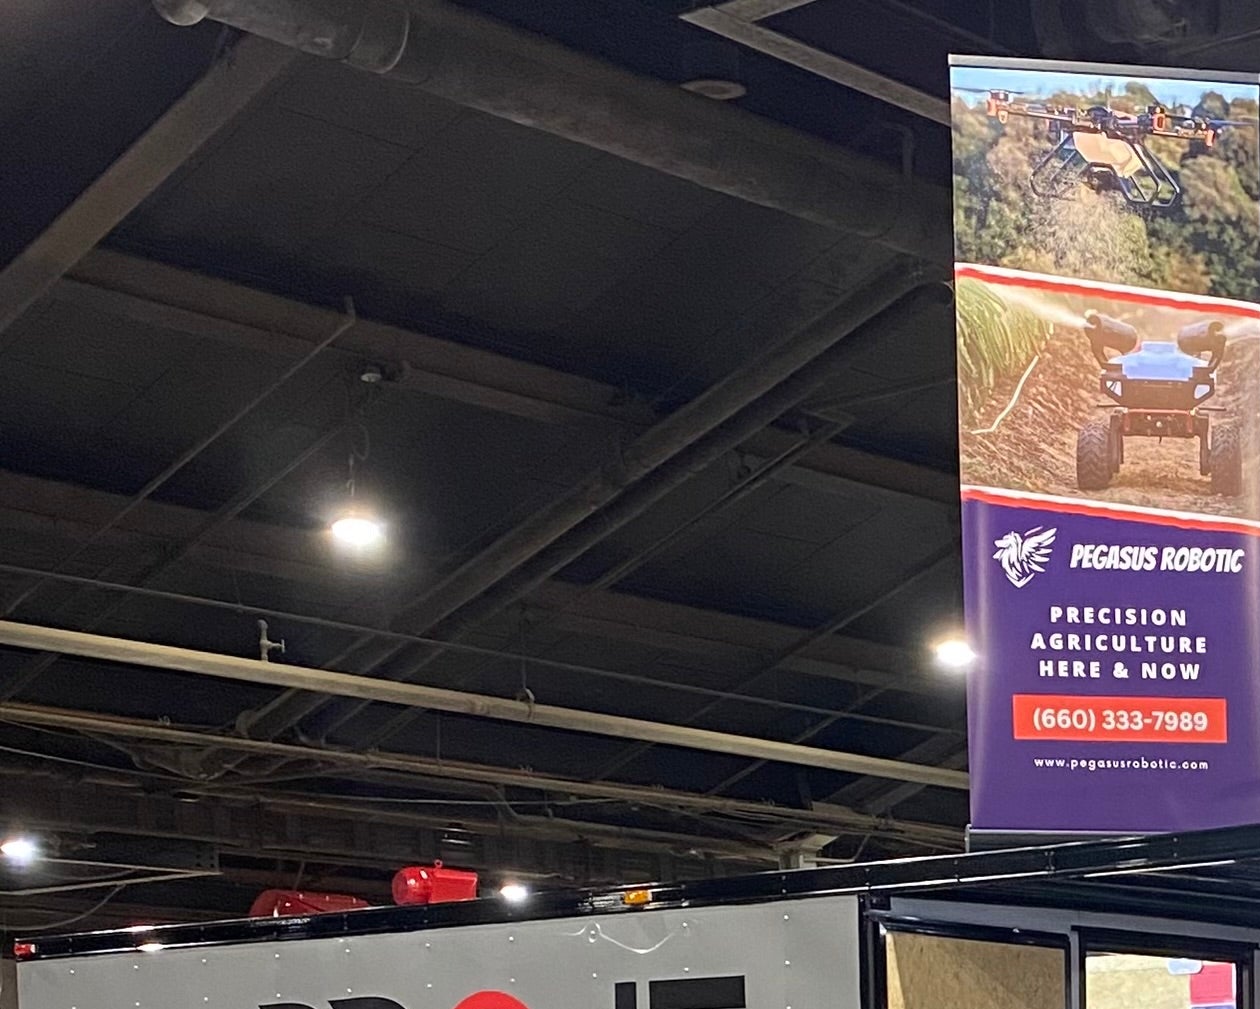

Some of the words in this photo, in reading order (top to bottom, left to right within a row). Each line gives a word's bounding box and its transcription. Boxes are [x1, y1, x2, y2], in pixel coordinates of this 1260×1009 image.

[1070, 544, 1157, 571] PEGASUS
[1160, 547, 1245, 573] ROBOTIC
[1050, 606, 1187, 626] PRECISION
[1030, 633, 1207, 653] AGRICULTURE
[1039, 660, 1101, 678] HERE
[1112, 662, 1129, 679] &
[1141, 663, 1200, 680] NOW
[1033, 708, 1096, 731] (660)
[1101, 709, 1208, 732] 333-7989
[1034, 757, 1208, 770] www.pegasusrobotic.com
